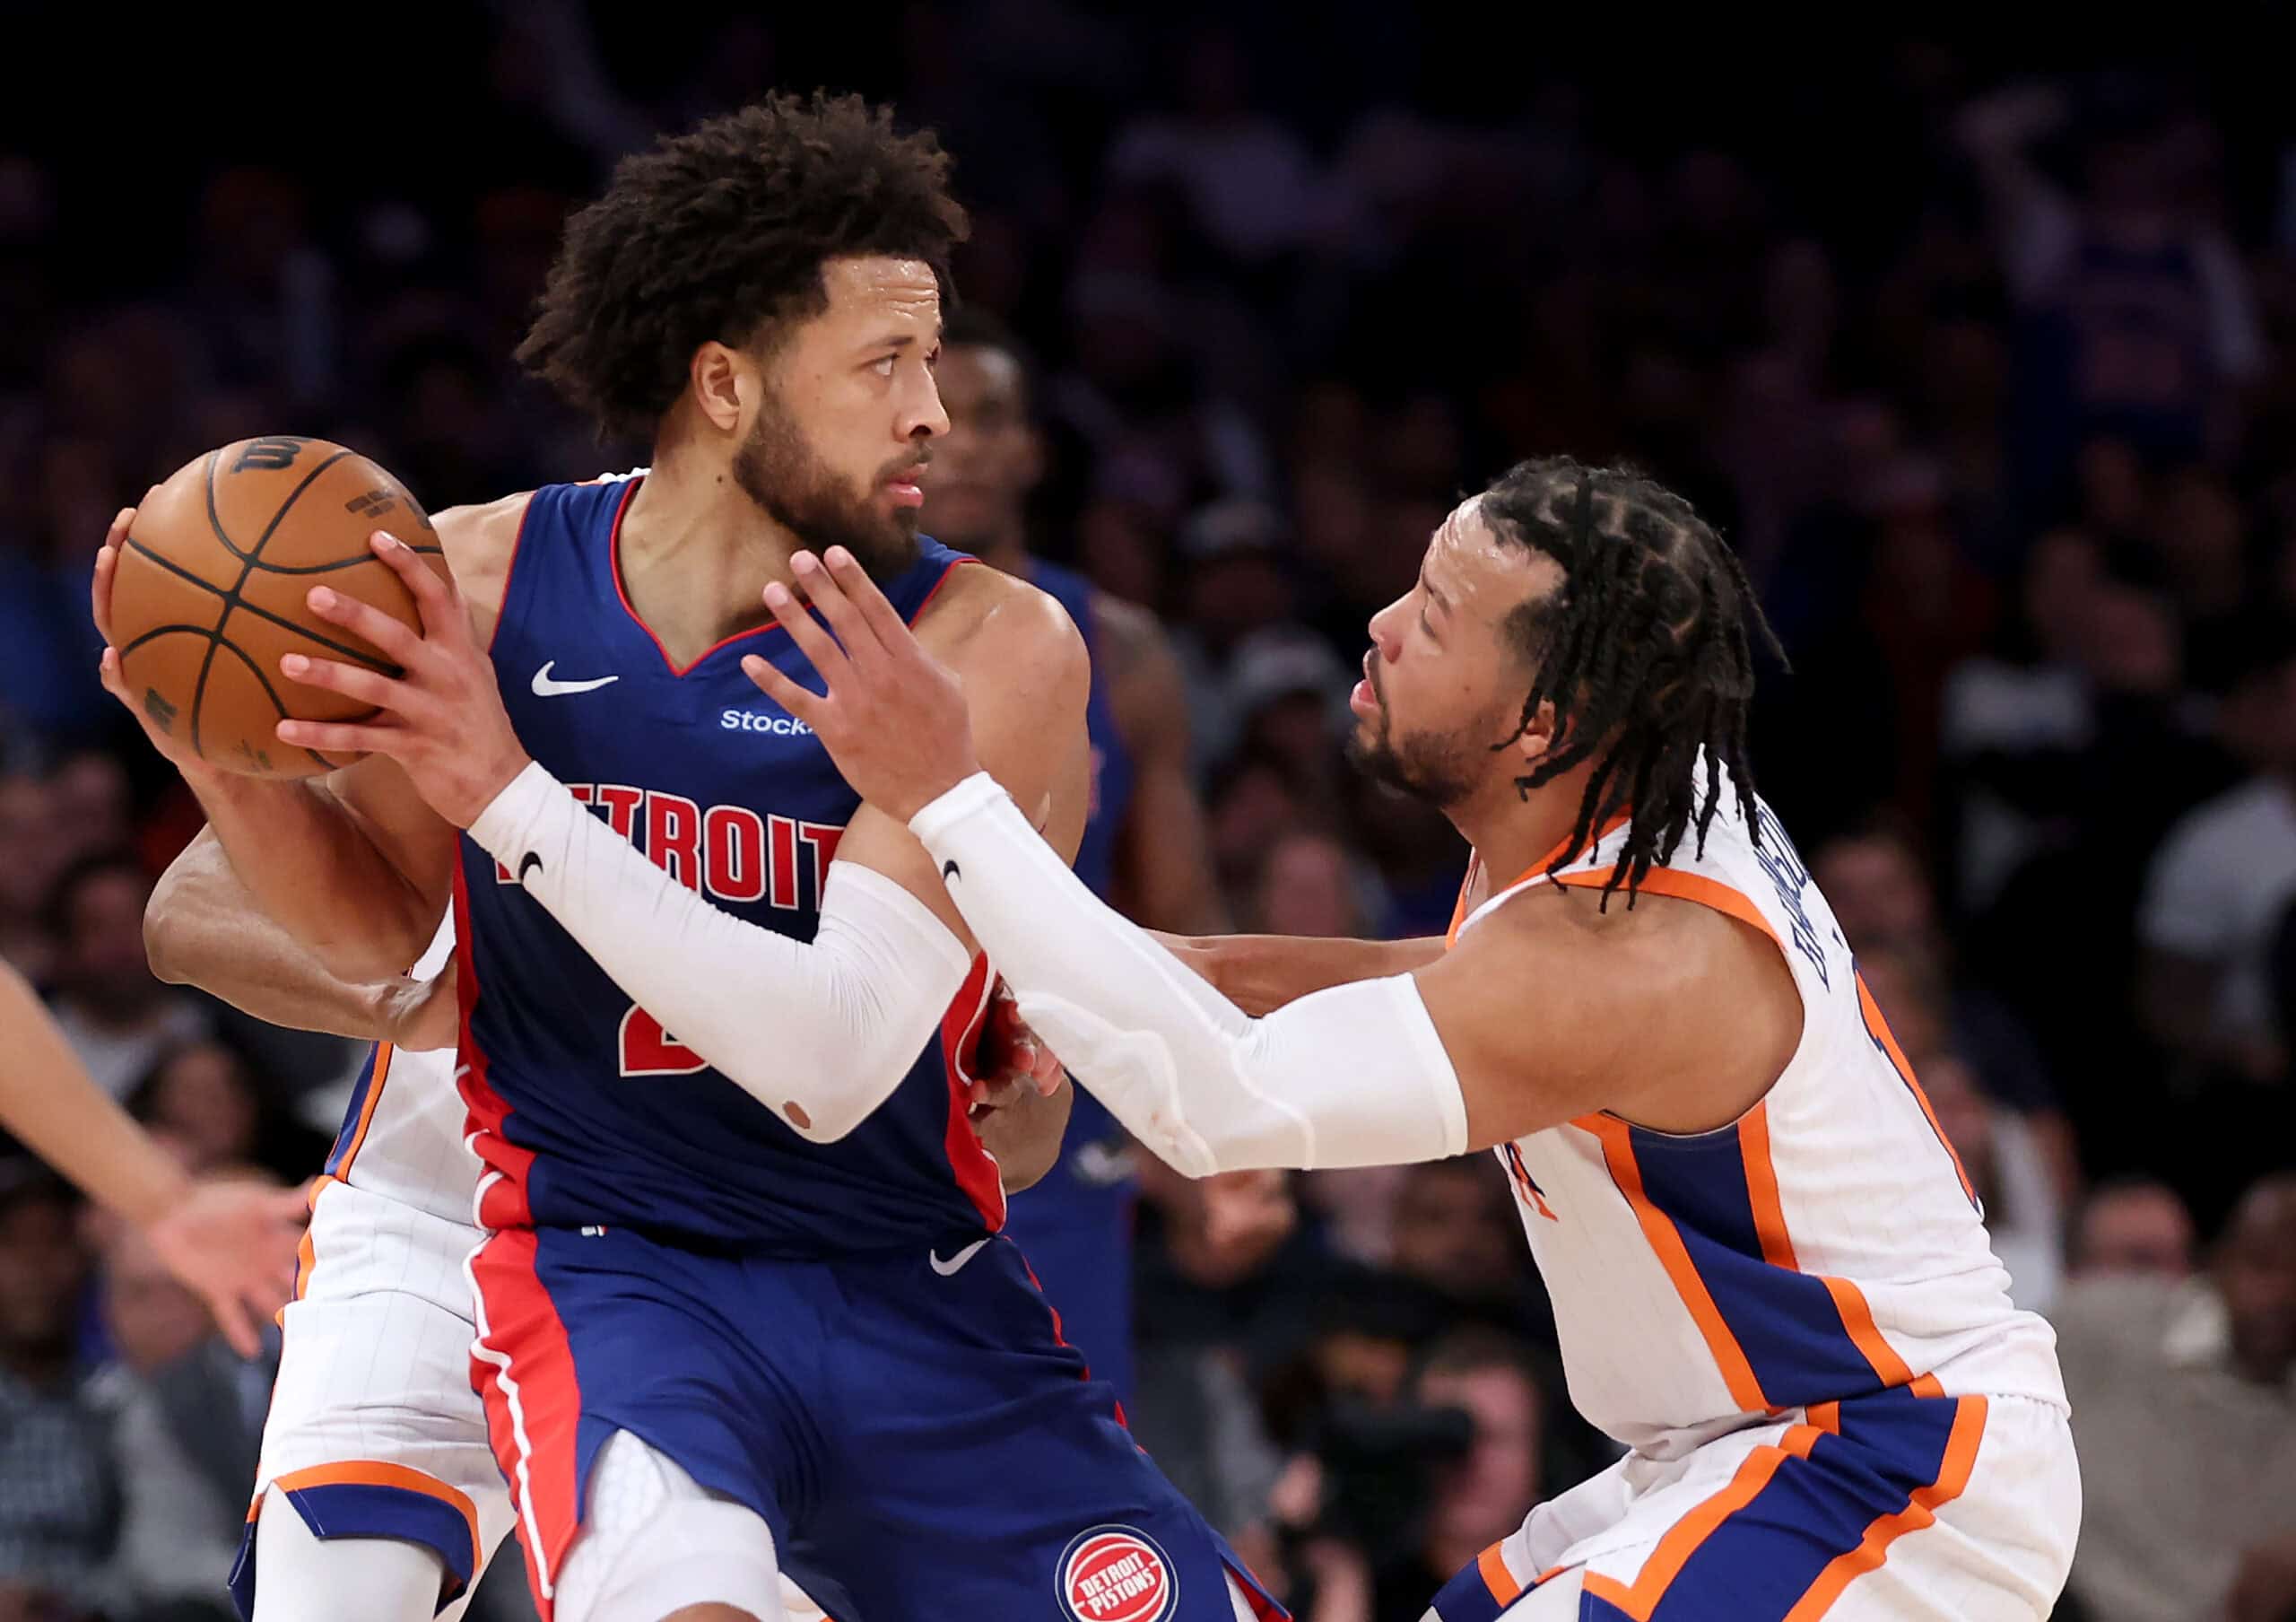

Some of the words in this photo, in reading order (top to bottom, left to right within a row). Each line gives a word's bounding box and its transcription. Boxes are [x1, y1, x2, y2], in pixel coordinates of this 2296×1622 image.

[720, 709, 813, 736] Stock
[495, 782, 846, 913] TROIT
[1077, 1550, 1144, 1599] DETROIT
[1087, 1567, 1157, 1618] PISTONS
